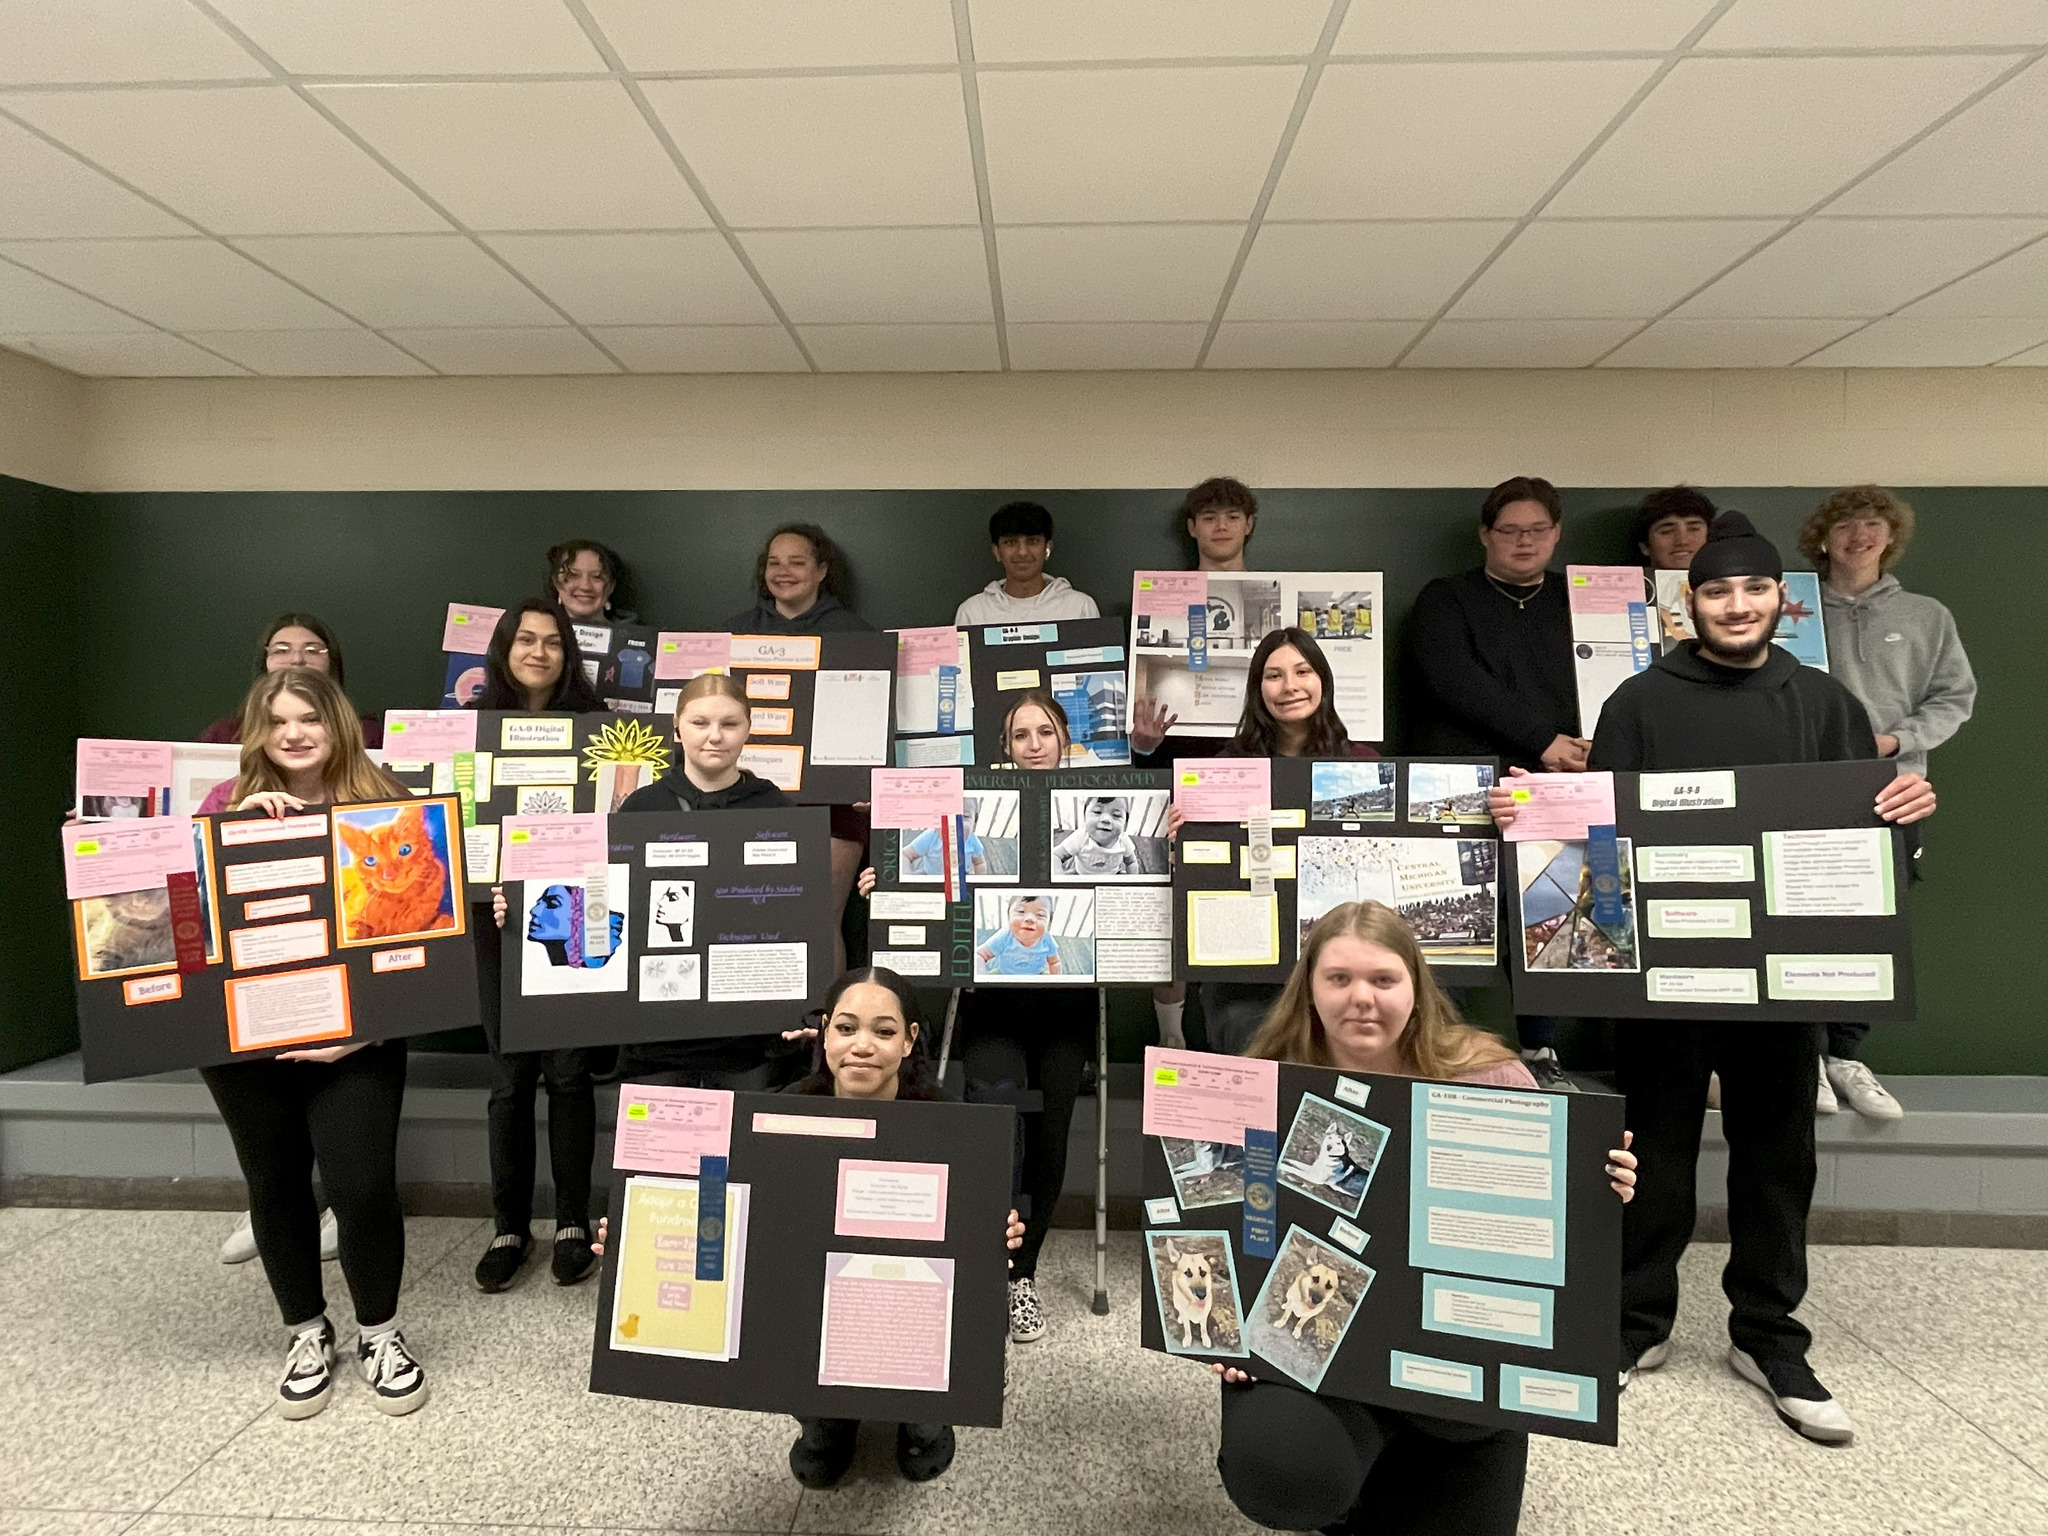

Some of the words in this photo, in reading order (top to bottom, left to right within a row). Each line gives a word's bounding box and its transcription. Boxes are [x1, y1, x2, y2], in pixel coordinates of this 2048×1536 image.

[580, 629, 603, 639] Design
[758, 645, 786, 657] GA-3
[750, 678, 765, 686] Soft
[767, 679, 787, 687] Ware
[767, 713, 787, 721] Ware
[535, 725, 565, 733] Digital
[509, 734, 560, 742] Illustration
[740, 754, 783, 765] Techniques
[1045, 771, 1156, 788] PHOTOGRAPHY
[1652, 799, 1678, 808] Digital
[1679, 797, 1724, 807] Illustration
[659, 832, 697, 841] Hardware
[755, 830, 789, 840] Software
[1397, 861, 1440, 871] CENTRAL
[1399, 870, 1447, 881] MICHIGAN
[1401, 878, 1456, 891] UNIVERSITY
[388, 952, 412, 963] After
[138, 982, 172, 996] Before
[1343, 1086, 1359, 1095] After
[1462, 1095, 1503, 1104] Commercial
[1504, 1097, 1549, 1109] Photography
[638, 1194, 674, 1209] Adopt
[677, 1199, 686, 1209] a
[1250, 1227, 1270, 1235] FIRST
[1340, 1226, 1360, 1240] Before
